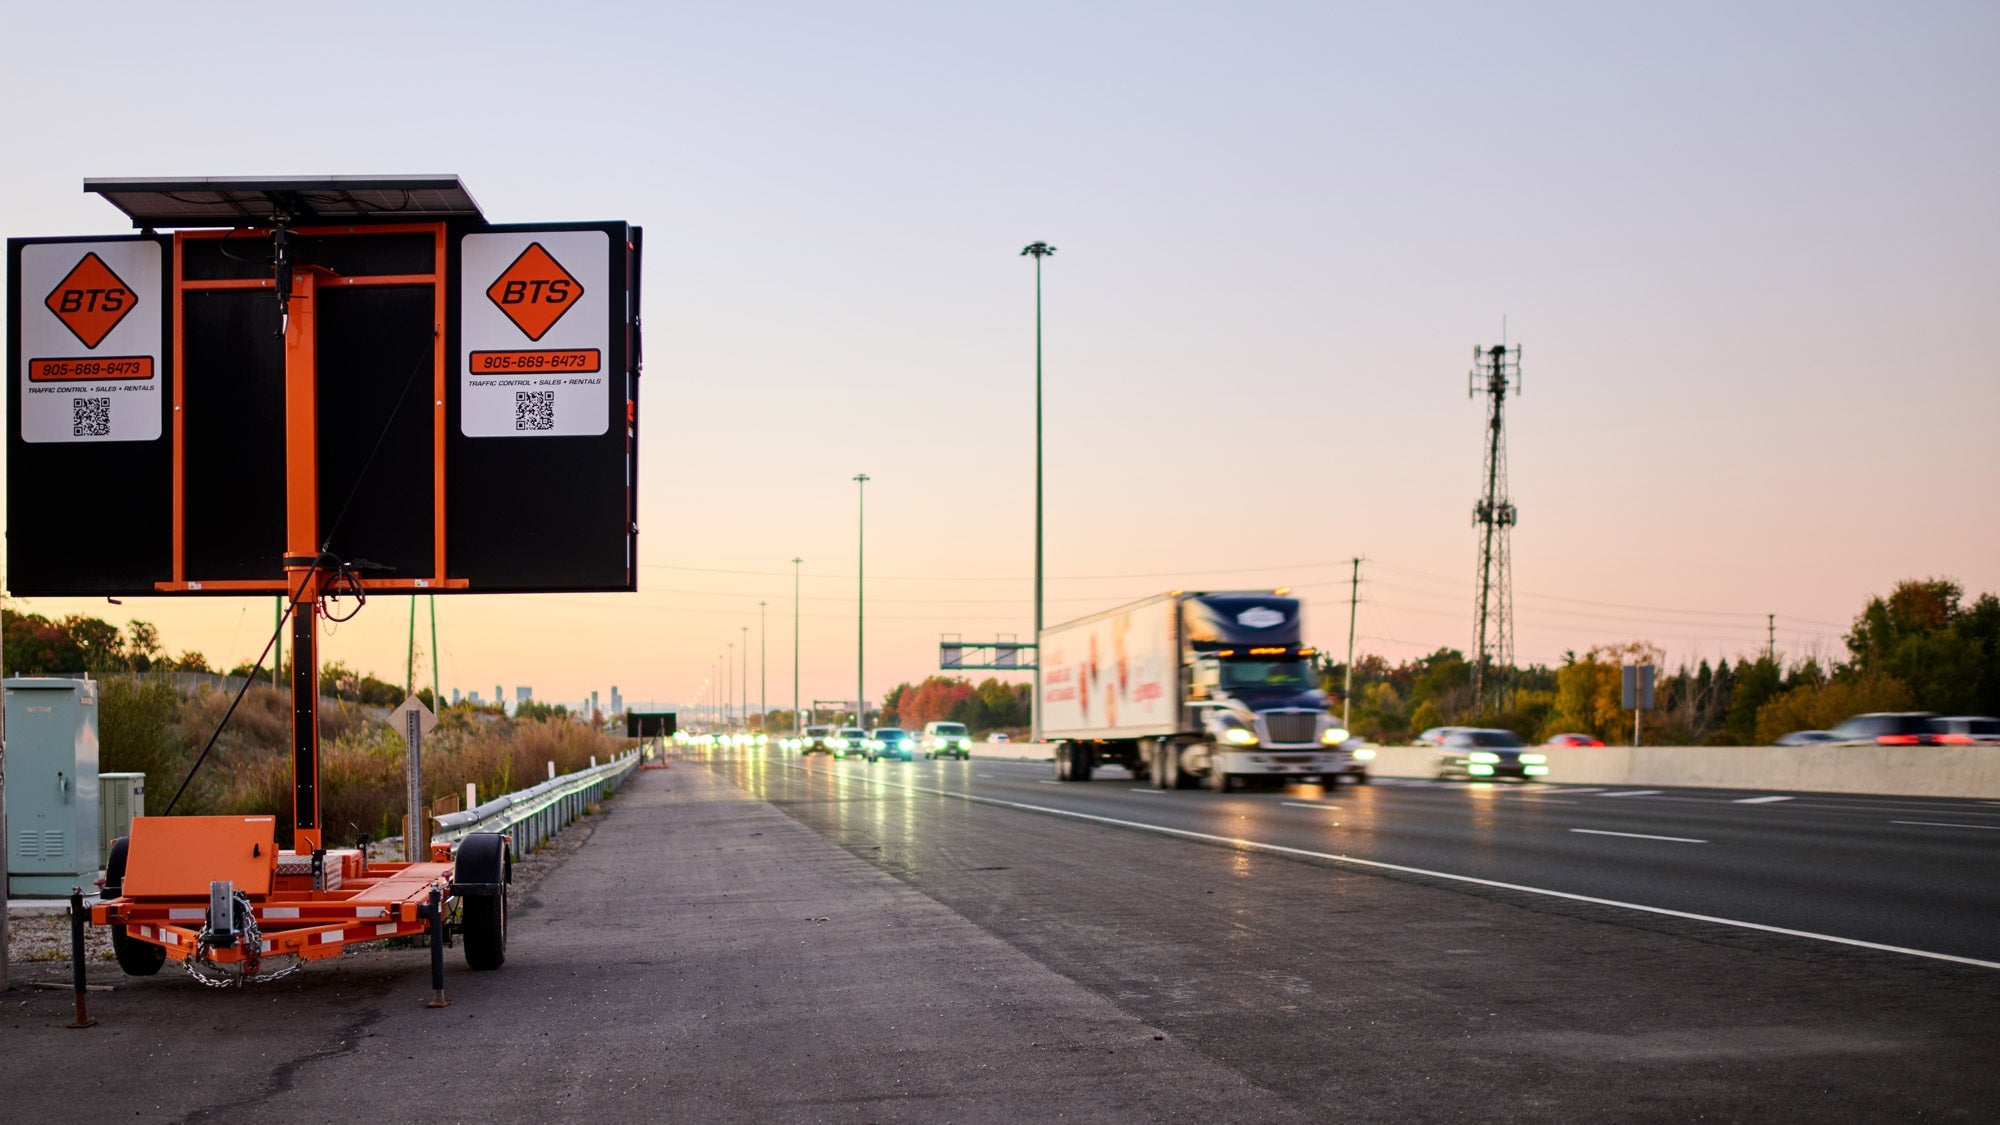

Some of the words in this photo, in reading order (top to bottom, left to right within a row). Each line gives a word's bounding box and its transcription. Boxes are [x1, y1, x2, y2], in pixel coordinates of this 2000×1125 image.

[59, 288, 125, 313] BTS
[502, 279, 571, 304] BTS
[42, 362, 140, 376] 905-669-6473
[484, 355, 586, 369] 905-669-6473
